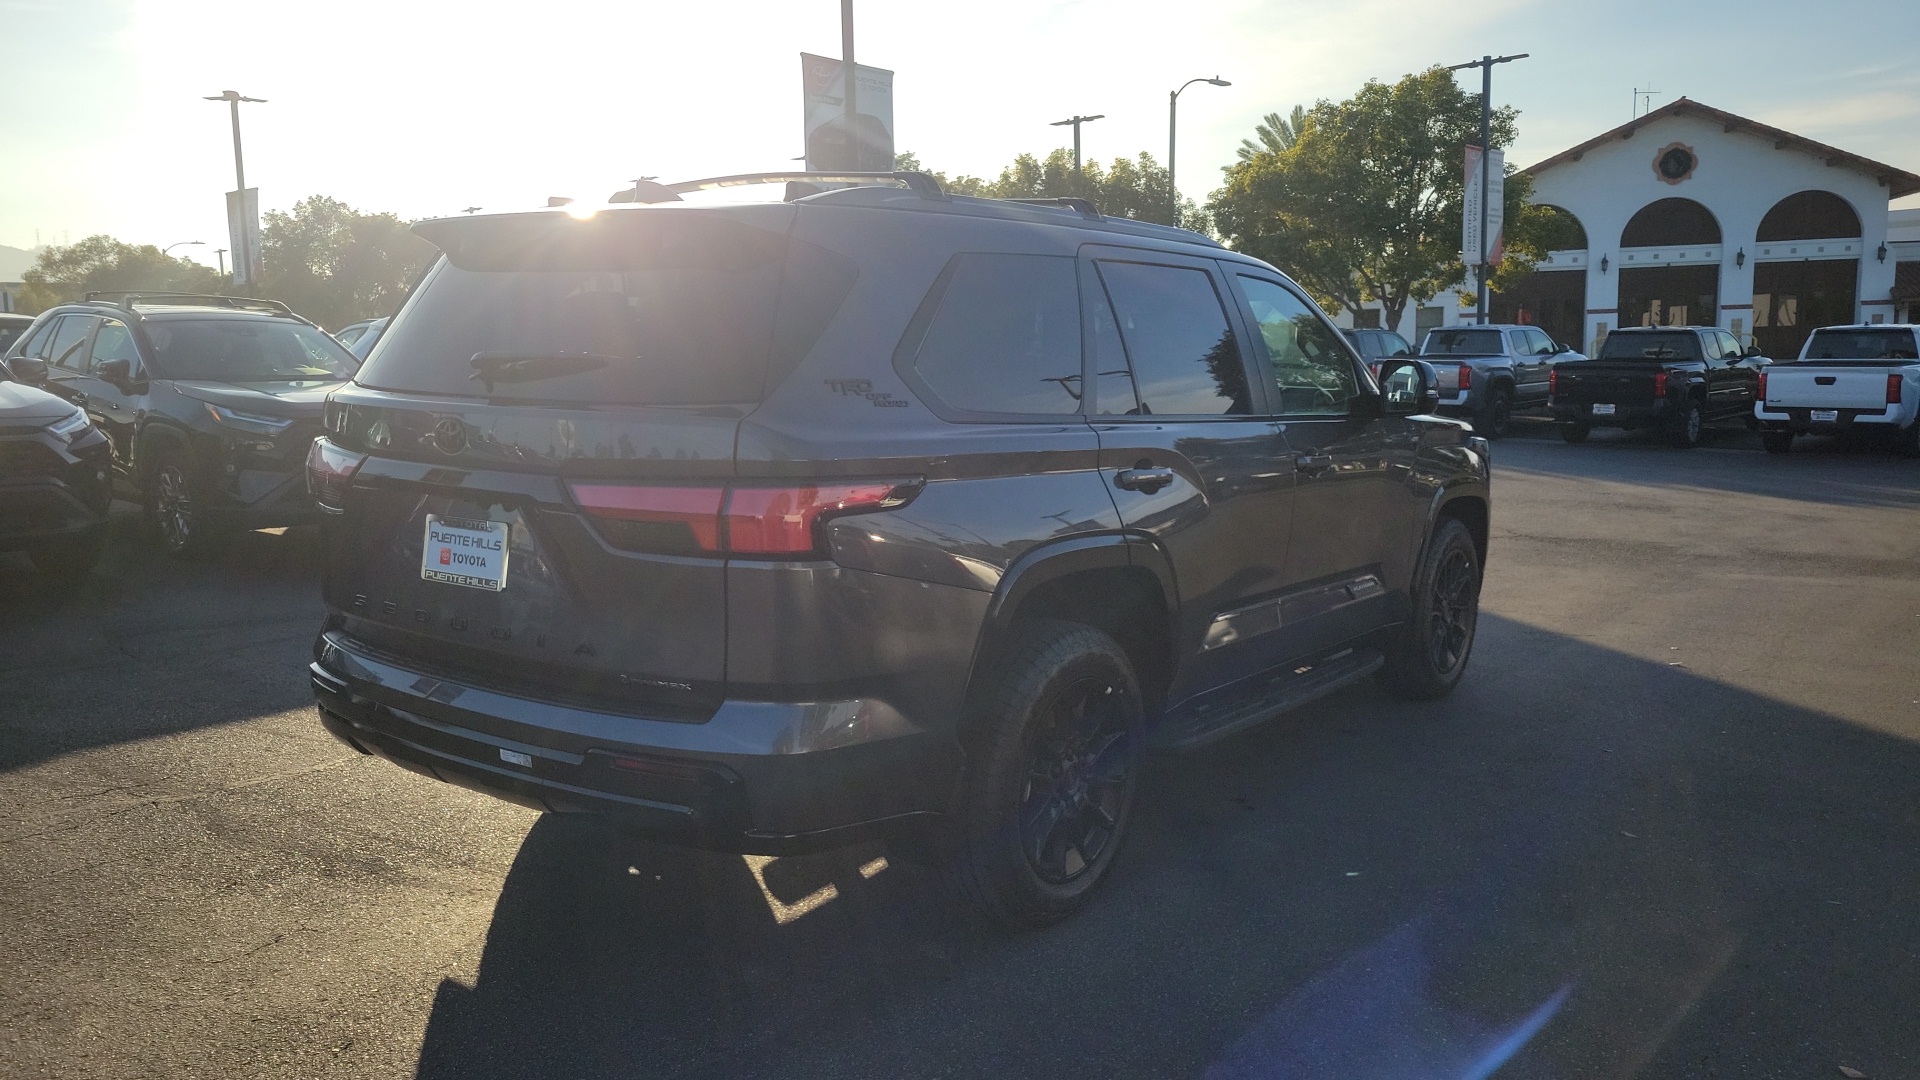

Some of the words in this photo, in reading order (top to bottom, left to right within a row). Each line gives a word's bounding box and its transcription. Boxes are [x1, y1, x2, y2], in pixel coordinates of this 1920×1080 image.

[430, 531, 470, 547] PUENTE
[471, 537, 502, 551] HILLS
[452, 552, 487, 568] TOYOTA
[425, 570, 466, 584] PUENTE
[466, 576, 497, 589] HILLS
